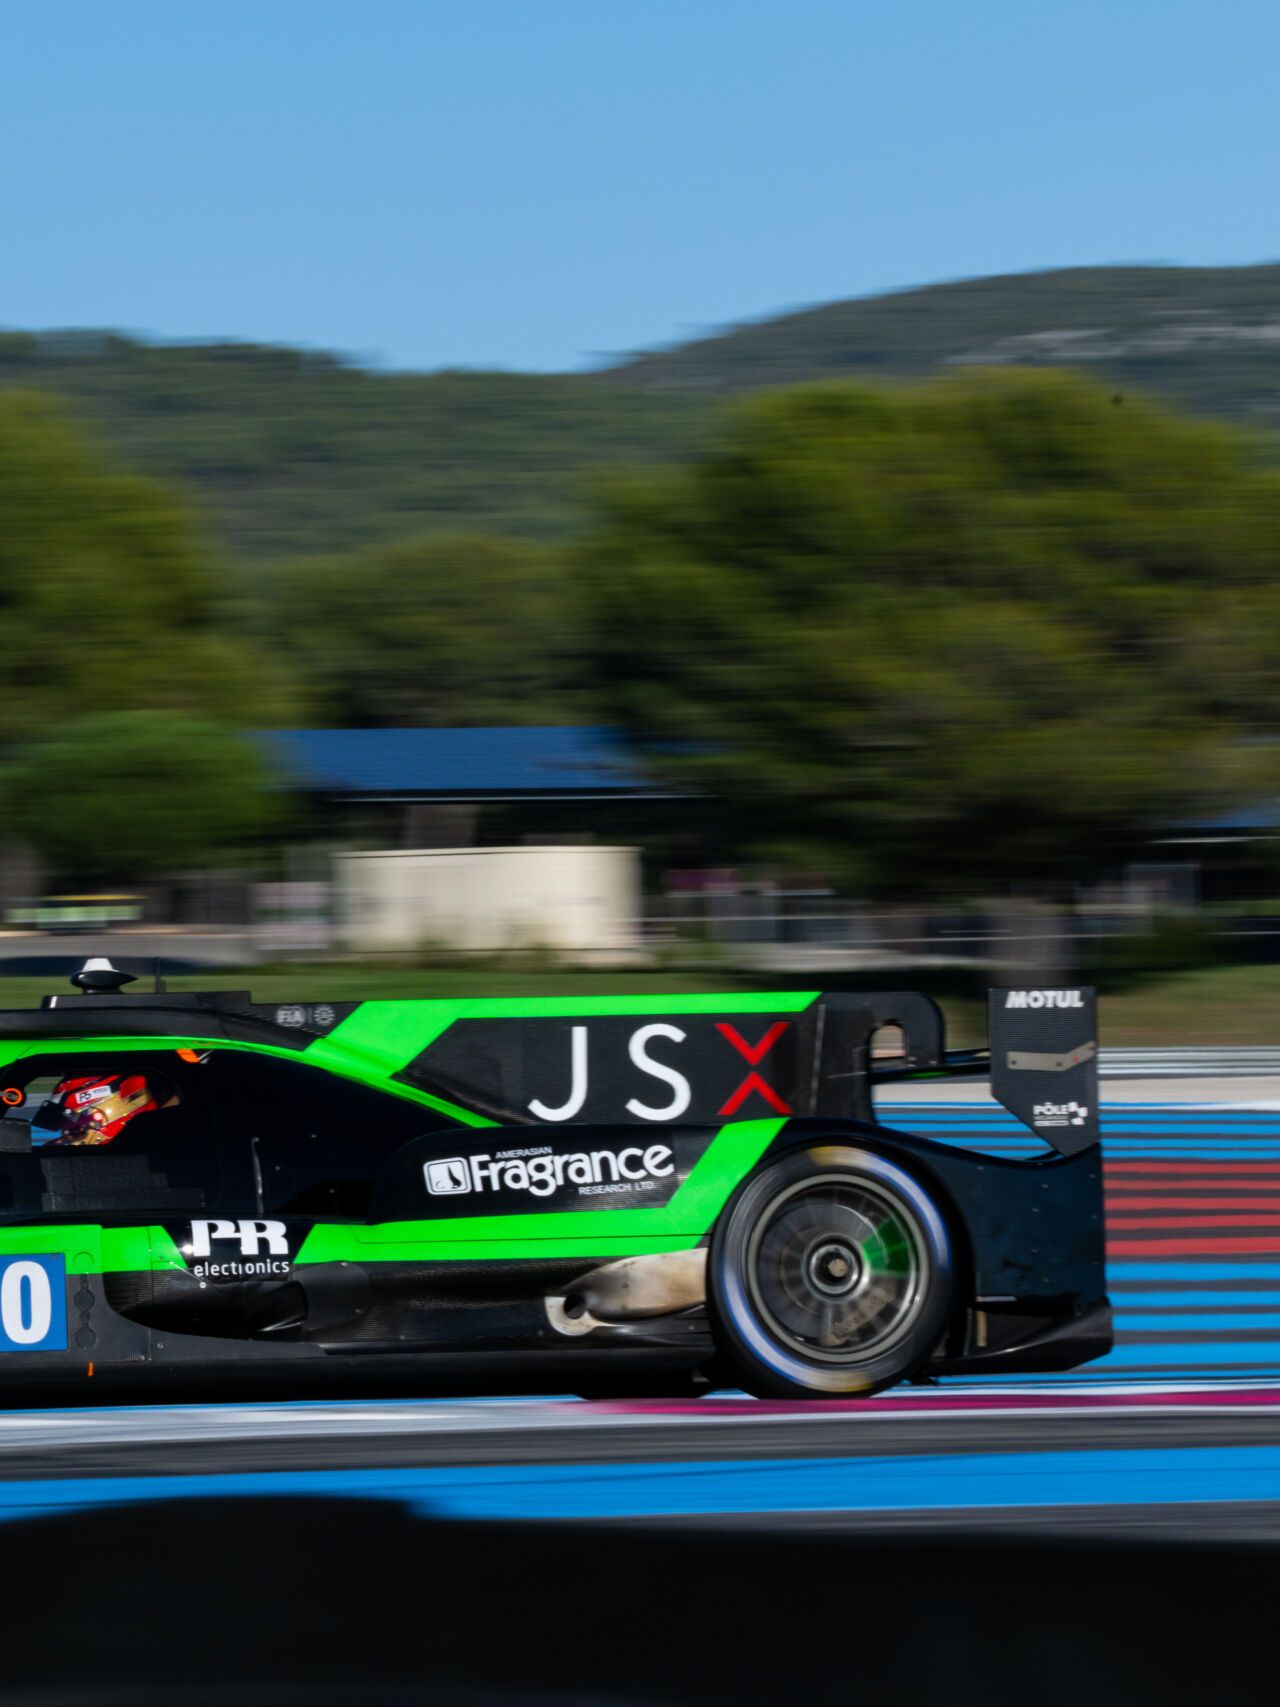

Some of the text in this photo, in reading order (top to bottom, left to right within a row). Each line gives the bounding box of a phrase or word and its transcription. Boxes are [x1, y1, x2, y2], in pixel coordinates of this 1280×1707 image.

[1004, 990, 1085, 1009] MOTUL
[276, 1010, 306, 1023] FIA
[527, 1021, 795, 1121] JSX
[1033, 1102, 1070, 1115] PÔLE
[495, 1147, 553, 1160] AMERASIAN
[469, 1144, 675, 1197] Fragrance
[578, 1182, 633, 1196] RESEARCH
[190, 1219, 290, 1257] PR
[193, 1259, 291, 1278] electronics
